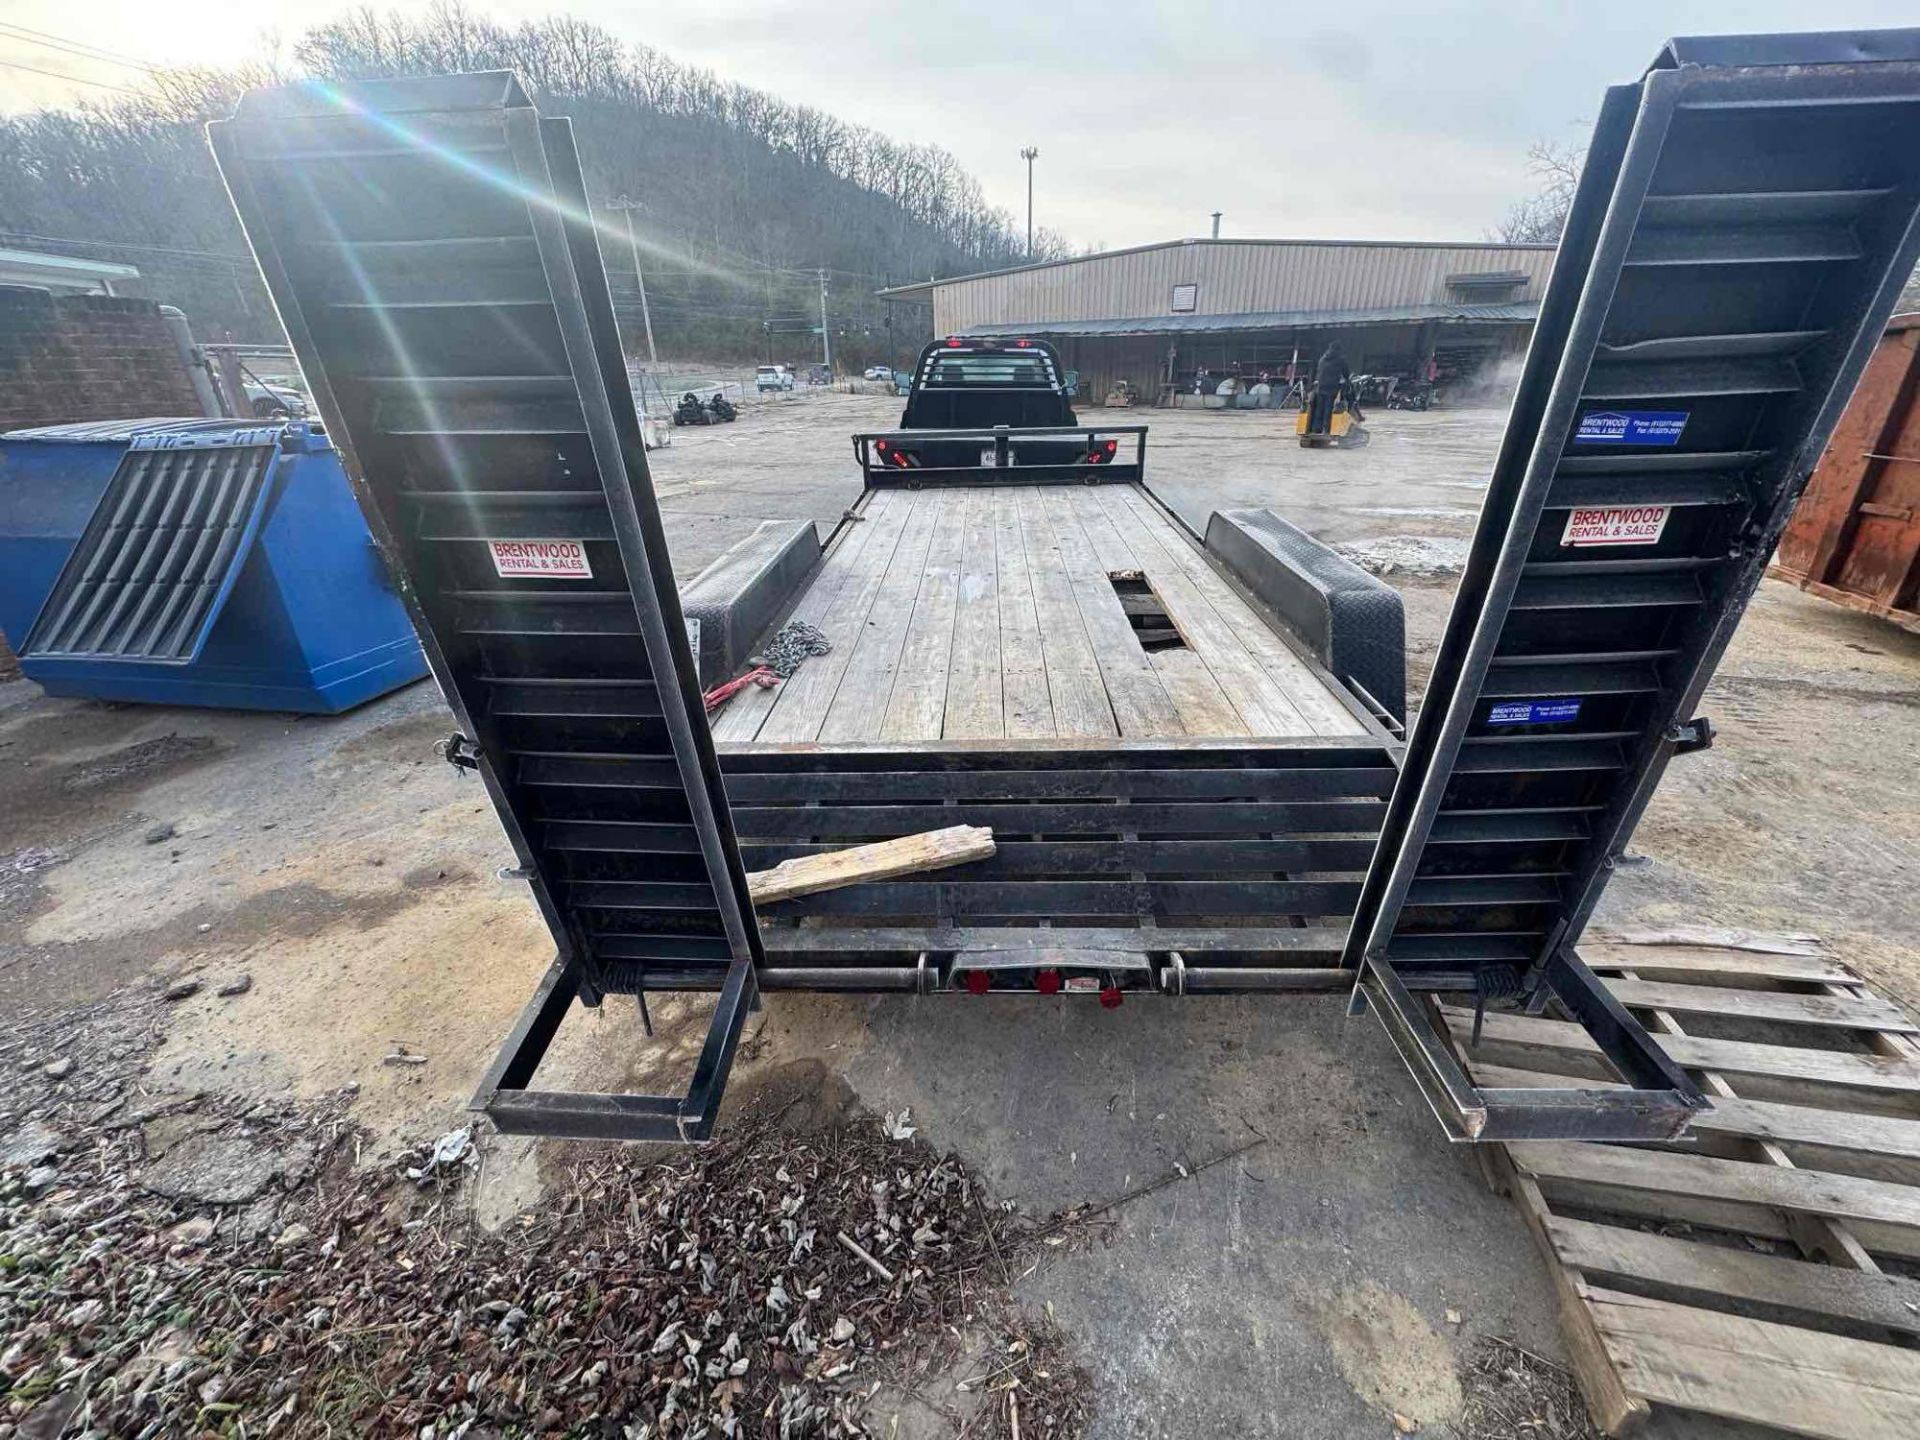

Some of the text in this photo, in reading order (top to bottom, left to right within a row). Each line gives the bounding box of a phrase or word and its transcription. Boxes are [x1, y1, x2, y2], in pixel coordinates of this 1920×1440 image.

[1581, 418, 1630, 427] BRENTWOOD
[1572, 507, 1665, 526] BRENTWOOD
[1568, 525, 1659, 537] RENTAL & SALES
[494, 543, 580, 558] BRENTWOOD
[500, 559, 584, 569] RENTAL & SALES
[1492, 705, 1532, 714] BRENTWOOD
